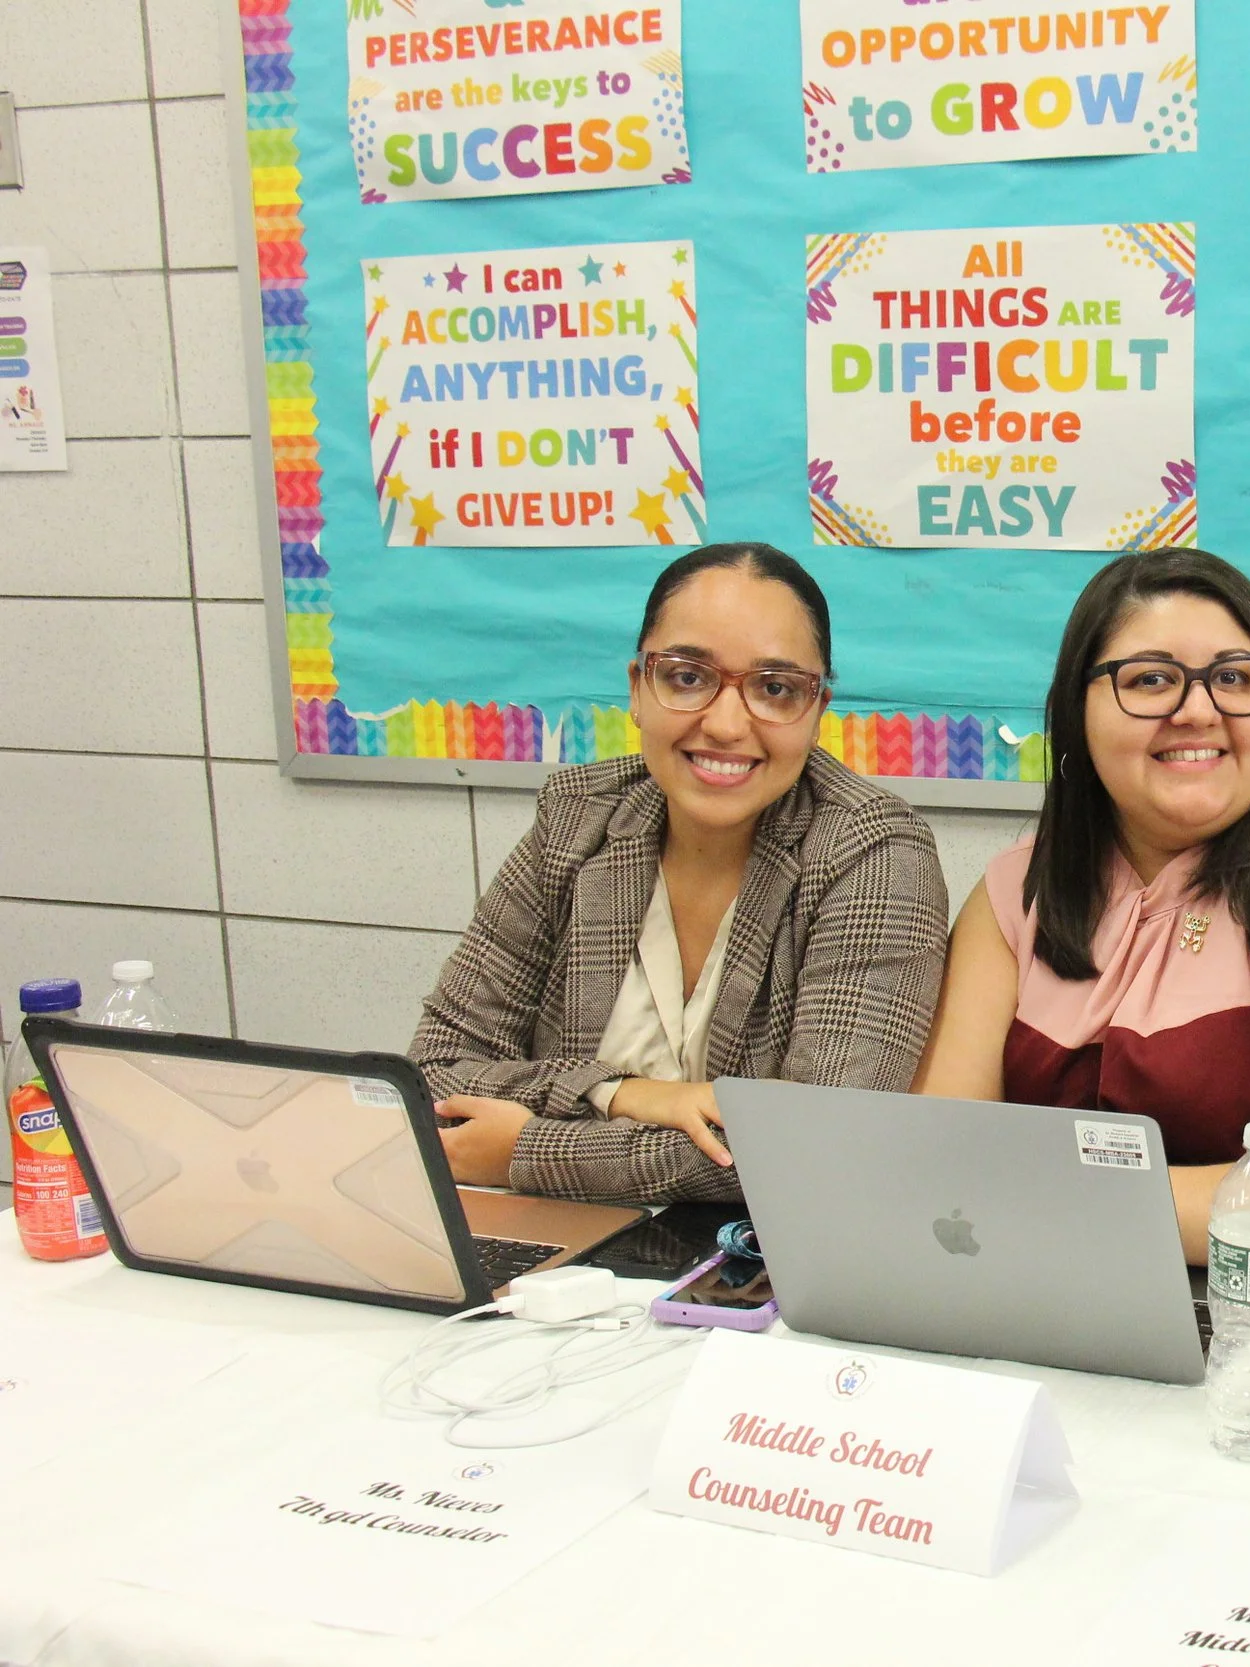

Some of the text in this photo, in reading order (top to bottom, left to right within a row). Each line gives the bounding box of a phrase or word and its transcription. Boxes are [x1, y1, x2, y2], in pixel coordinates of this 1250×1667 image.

[365, 8, 662, 68] PERSEVERANCE
[822, 5, 1170, 68] OPPORTUNITY
[395, 70, 631, 112] are the keys to
[848, 71, 1144, 141] to GROW
[384, 115, 652, 187] SUCCESS
[484, 264, 562, 294] I can
[962, 240, 1023, 278] All
[401, 298, 657, 345] ACCOMPLISH,
[873, 287, 1122, 330] THINGS ARE
[400, 354, 662, 403] ANYTHING,
[831, 338, 1169, 393] DIFFICULT
[909, 398, 1082, 443] before
[429, 427, 634, 469] if I DON'T
[936, 449, 1058, 479] they are
[456, 490, 615, 528] GIVE UP!
[917, 484, 1077, 537] EASY
[43, 1164, 67, 1173] Facts
[36, 1190, 50, 1199] 100
[53, 1189, 68, 1199] 240
[724, 1412, 933, 1477] Middle School
[278, 1496, 509, 1544] 7th gd Counselor
[359, 1481, 504, 1514] Ms. Nieves
[688, 1467, 933, 1545] Counseling Team
